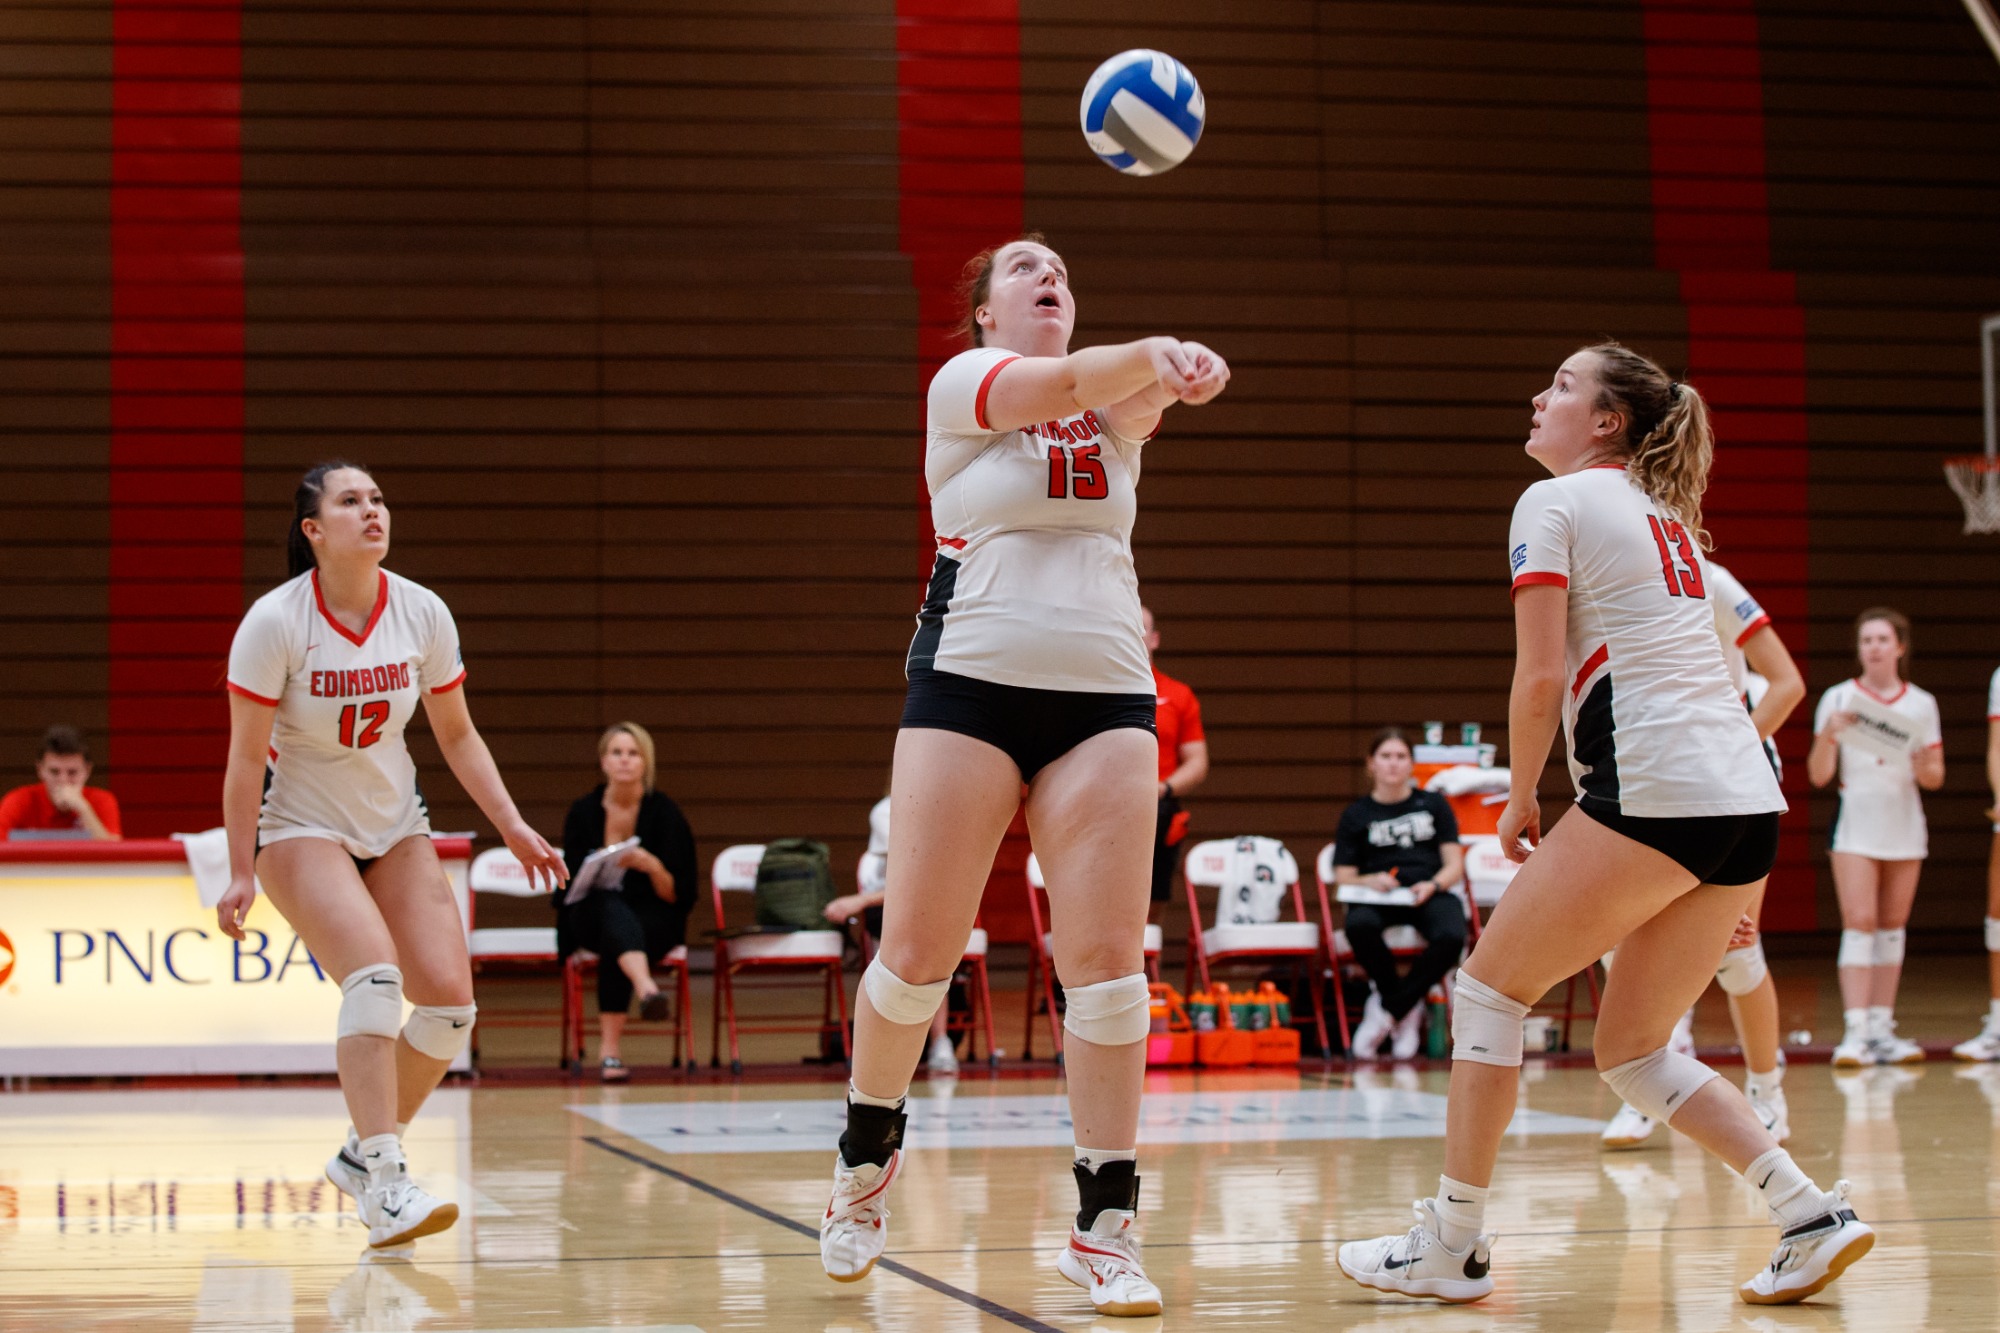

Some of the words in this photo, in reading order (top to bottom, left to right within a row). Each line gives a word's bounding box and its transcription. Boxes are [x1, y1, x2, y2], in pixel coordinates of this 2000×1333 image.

[1047, 443, 1109, 500] 15
[1646, 514, 1706, 600] 13
[310, 662, 410, 698] EDINBORO
[338, 700, 391, 749] 12
[47, 928, 212, 985] PNC
[231, 928, 327, 984] BA
